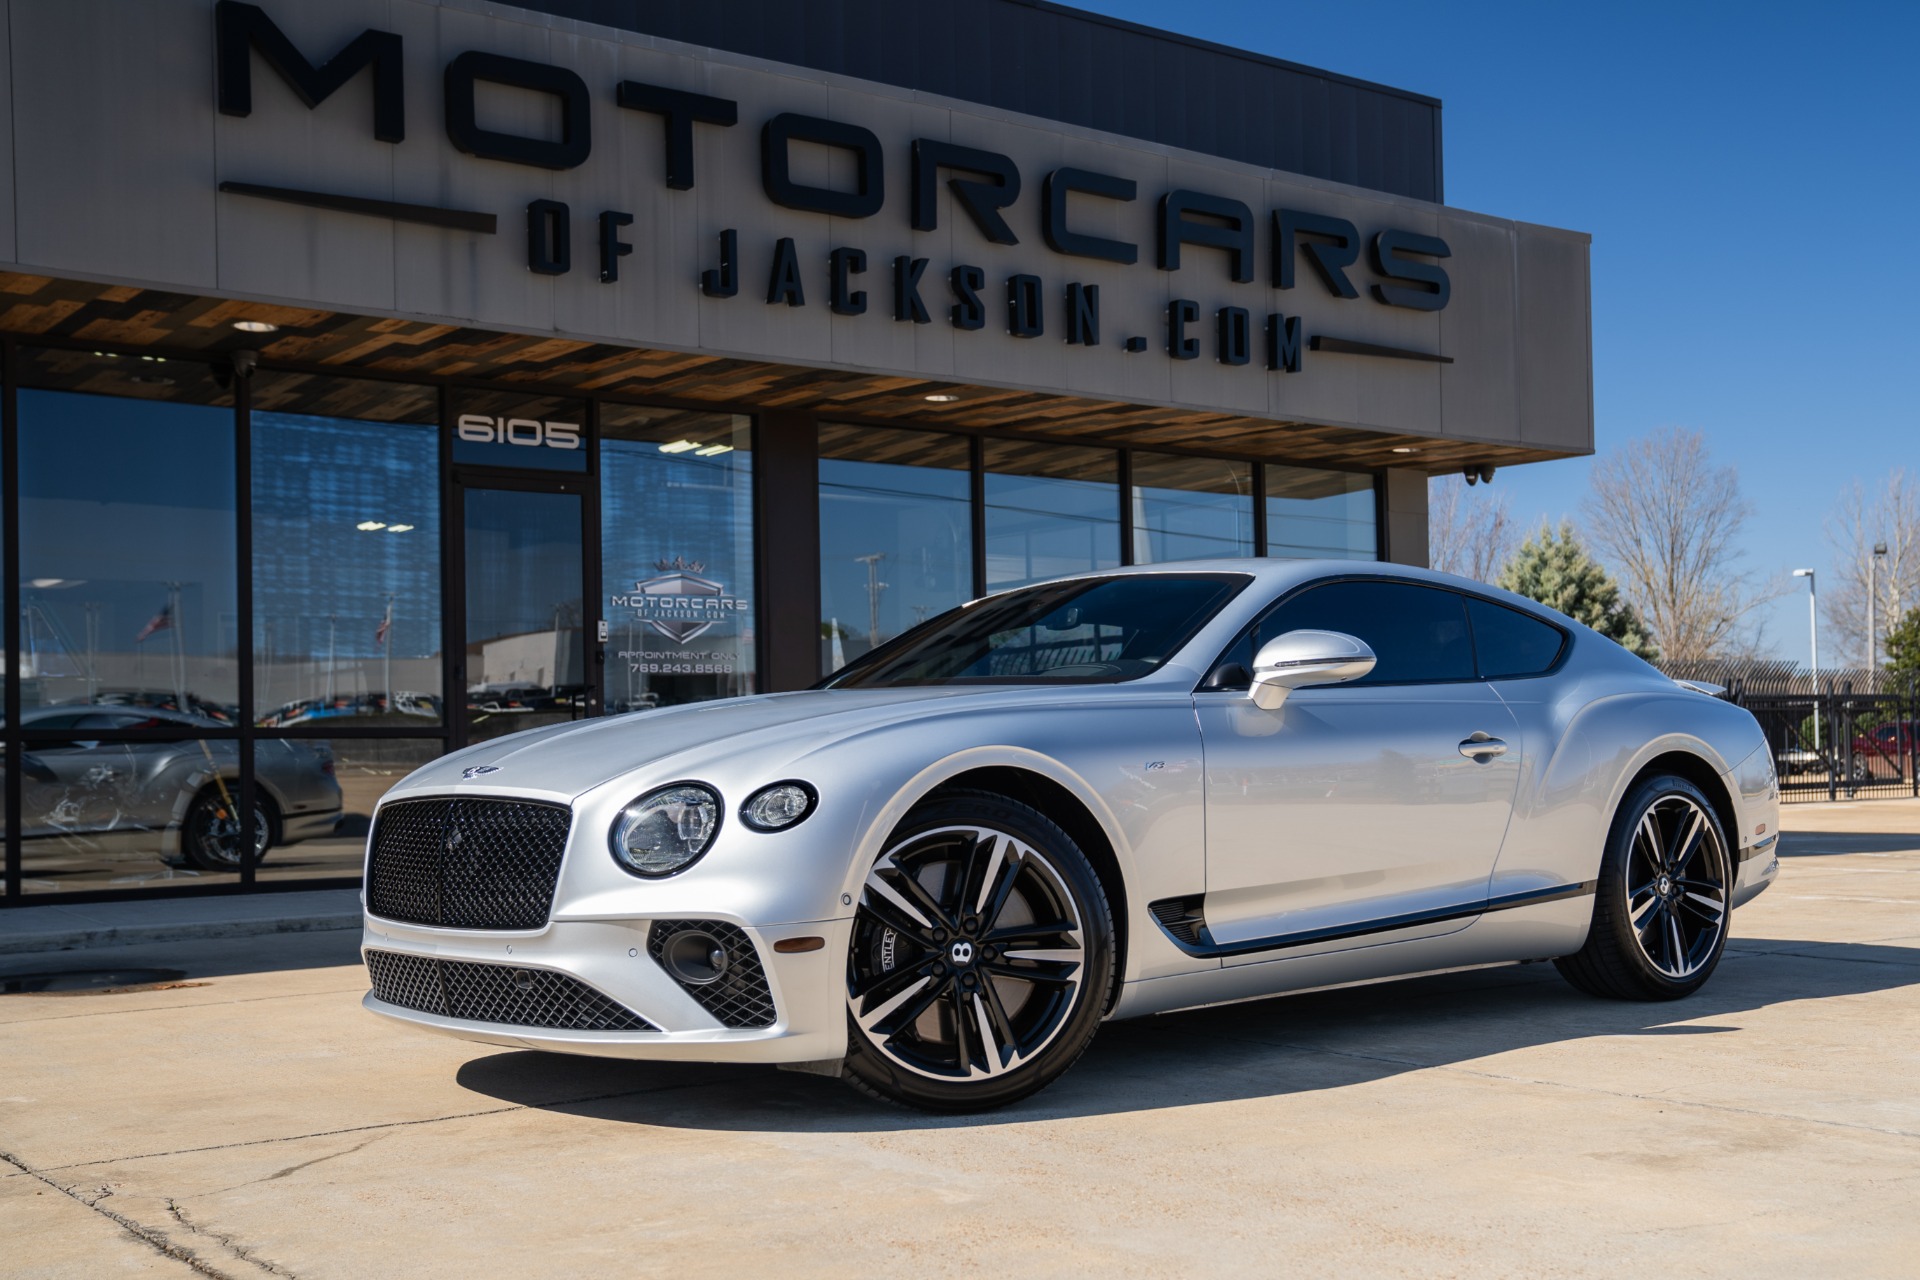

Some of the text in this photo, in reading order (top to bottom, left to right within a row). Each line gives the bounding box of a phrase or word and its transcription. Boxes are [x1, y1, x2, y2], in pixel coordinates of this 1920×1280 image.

[216, 1, 1451, 311] MOTORCARS
[527, 199, 633, 284] OF
[458, 414, 580, 449] 6105
[612, 595, 748, 610] MOTORCARS
[637, 609, 649, 617] OF
[618, 651, 741, 661] APPOINTMENT ONLY
[630, 663, 733, 674] 769.243.8568
[883, 928, 896, 971] ENTLEY
